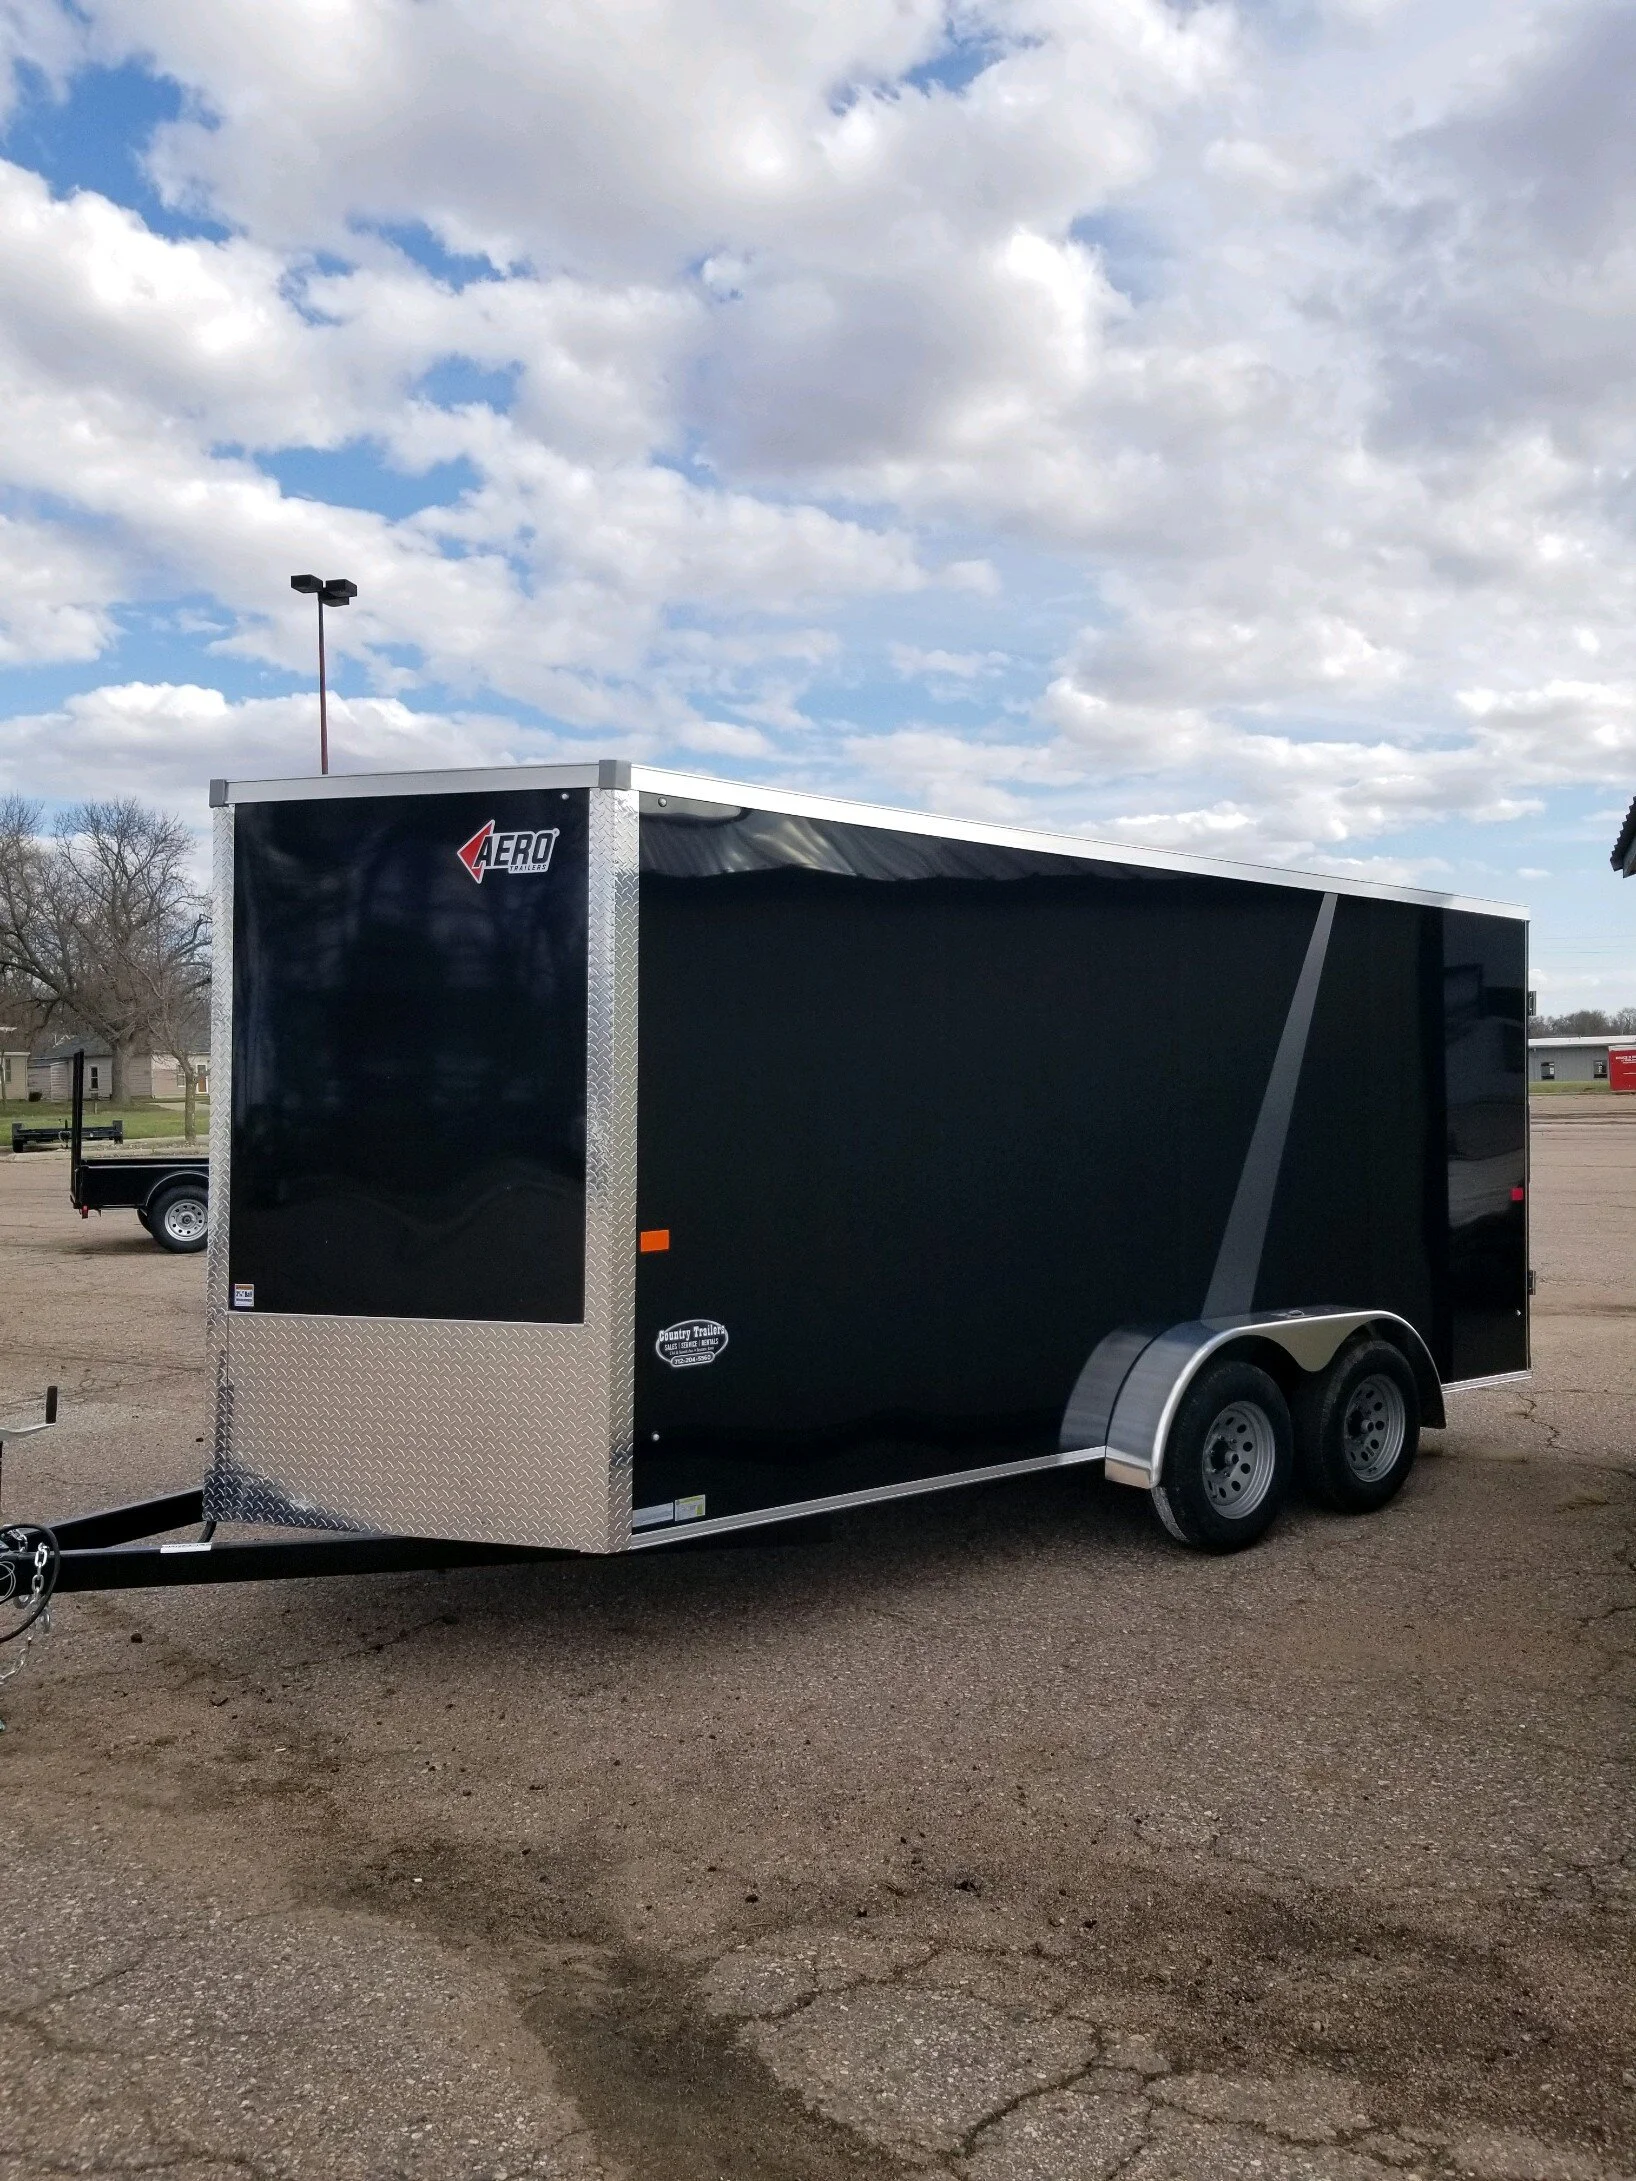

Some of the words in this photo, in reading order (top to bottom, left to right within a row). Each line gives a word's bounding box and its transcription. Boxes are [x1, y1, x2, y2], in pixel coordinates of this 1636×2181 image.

[472, 832, 554, 867] AERO
[509, 864, 547, 872] TRAILERS
[659, 1329, 690, 1341] Country
[693, 1324, 726, 1337] Trailers
[664, 1343, 677, 1351] SALES
[681, 1340, 697, 1348] SERVICE
[701, 1338, 719, 1346] RENTALS
